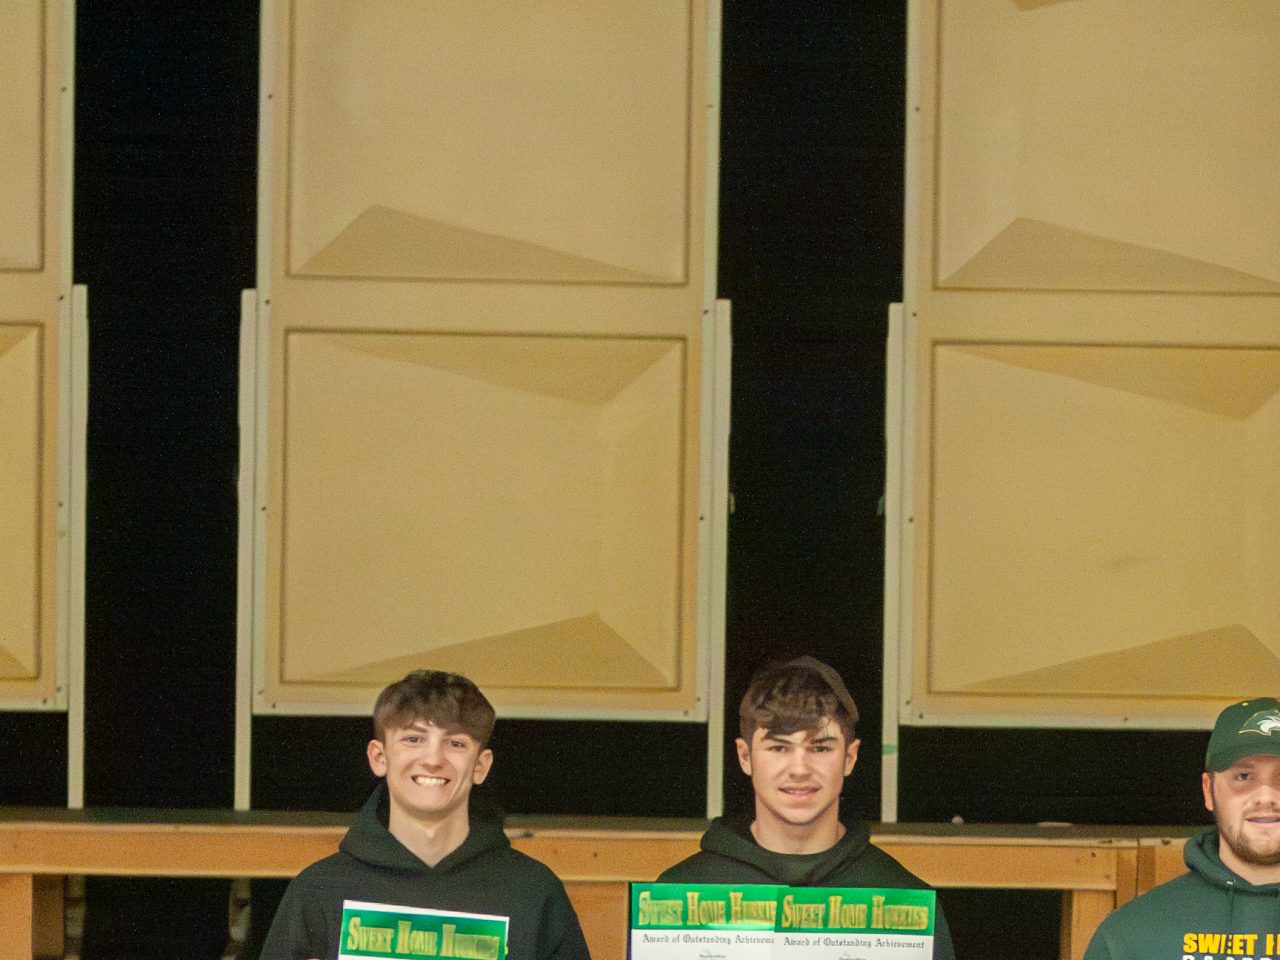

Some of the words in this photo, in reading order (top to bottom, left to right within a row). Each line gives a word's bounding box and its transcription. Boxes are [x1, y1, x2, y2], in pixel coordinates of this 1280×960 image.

[642, 934, 669, 943] Award
[672, 934, 681, 943] of
[683, 935, 731, 945] Outstanding
[784, 937, 810, 947] Award
[813, 937, 821, 947] of
[823, 938, 872, 948] Outstanding
[875, 938, 926, 949] Achievement
